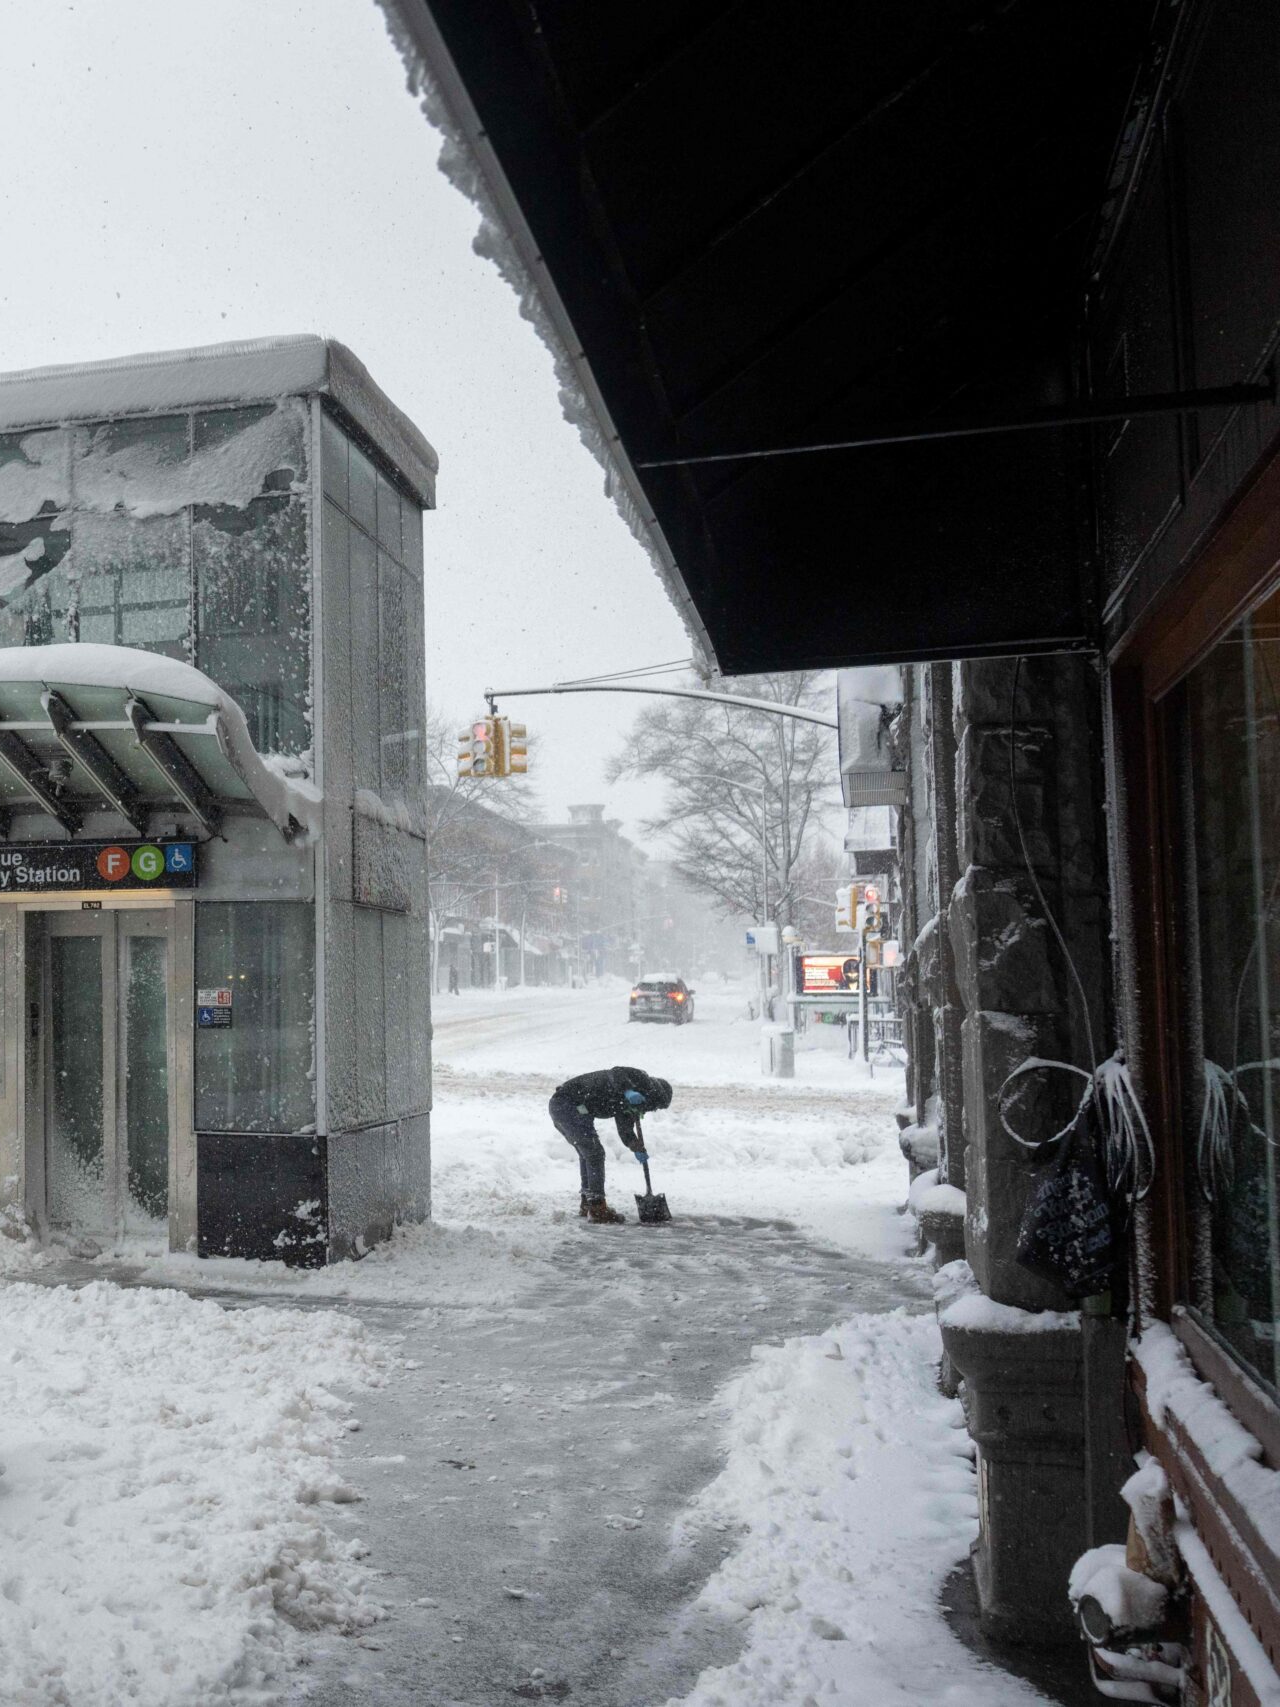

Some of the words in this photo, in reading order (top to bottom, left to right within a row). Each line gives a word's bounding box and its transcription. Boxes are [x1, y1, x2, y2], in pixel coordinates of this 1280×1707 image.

[107, 854, 121, 874] F
[139, 852, 157, 872] G
[15, 866, 80, 883] Station
